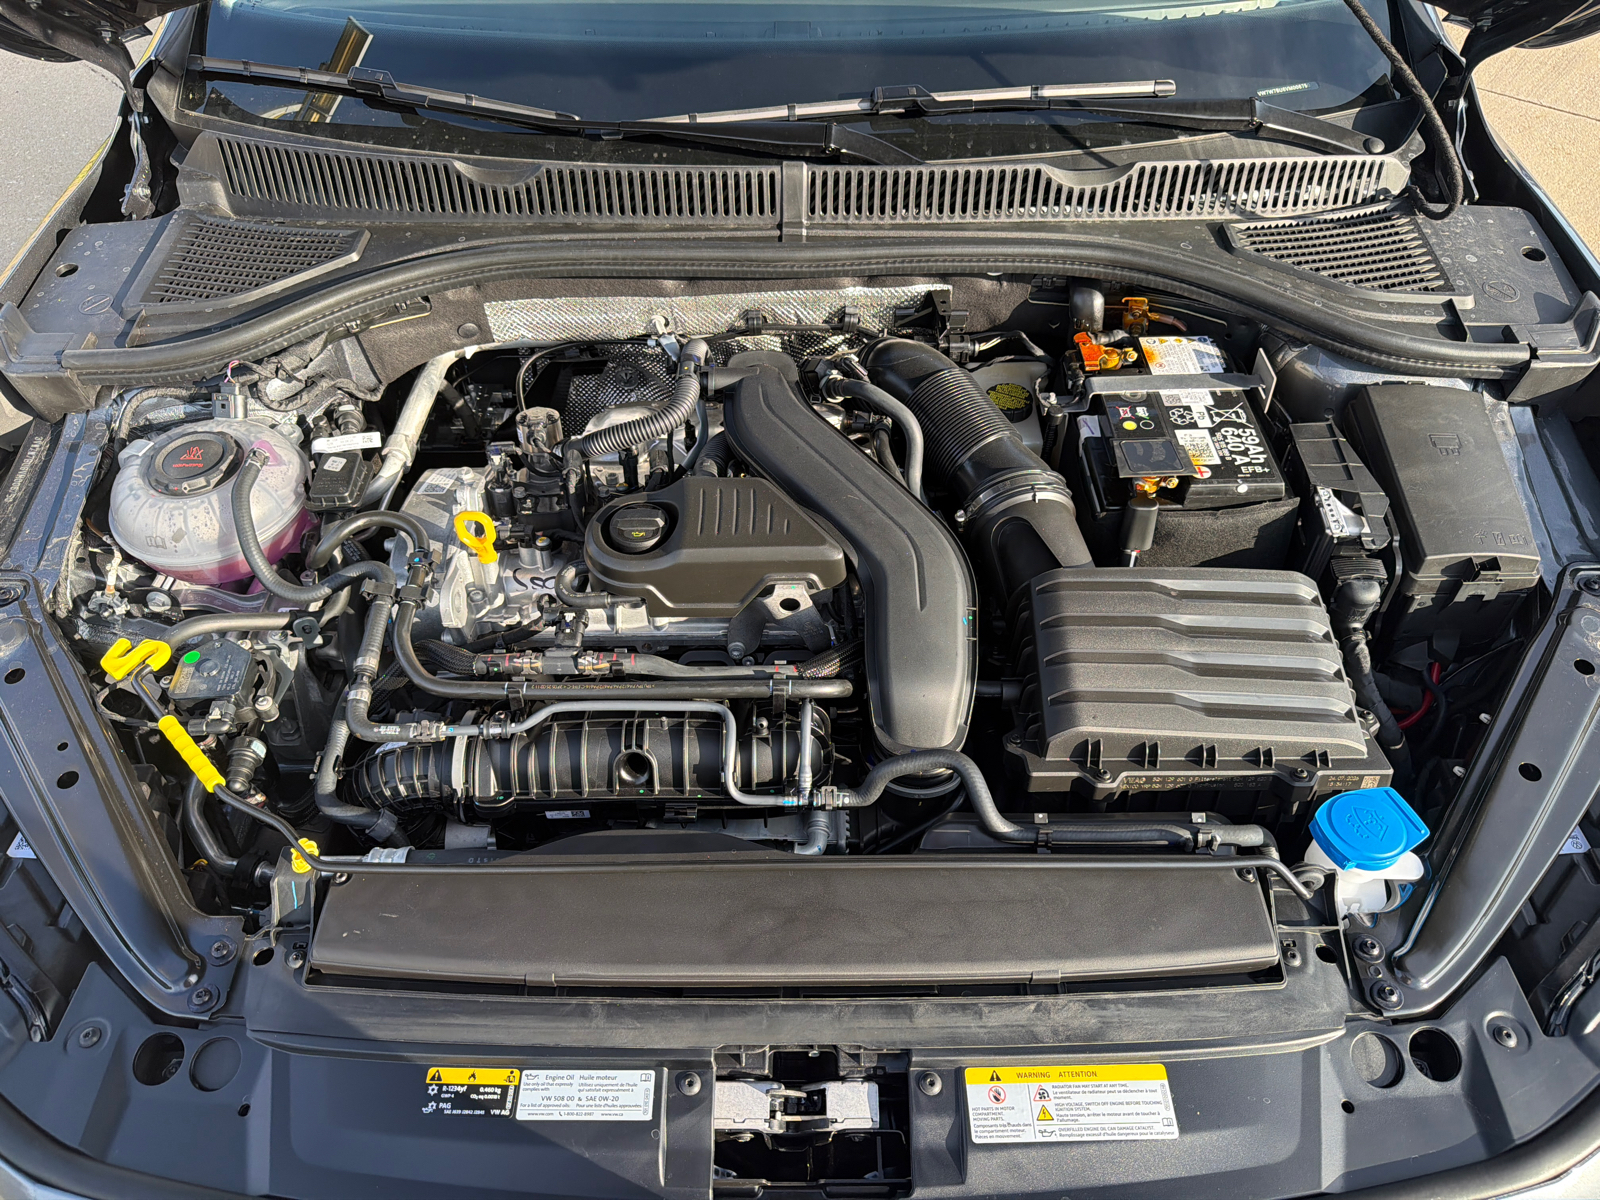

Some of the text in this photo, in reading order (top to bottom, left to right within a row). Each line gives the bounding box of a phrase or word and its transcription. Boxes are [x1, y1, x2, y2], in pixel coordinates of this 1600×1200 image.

[1220, 427, 1245, 452] 640
[1238, 428, 1268, 464] 59Ah
[1231, 454, 1251, 466] A
[1240, 466, 1271, 474] EFB+
[545, 1074, 565, 1082] Engine
[442, 1085, 468, 1093] R-1234yf
[495, 1086, 502, 1094] kg
